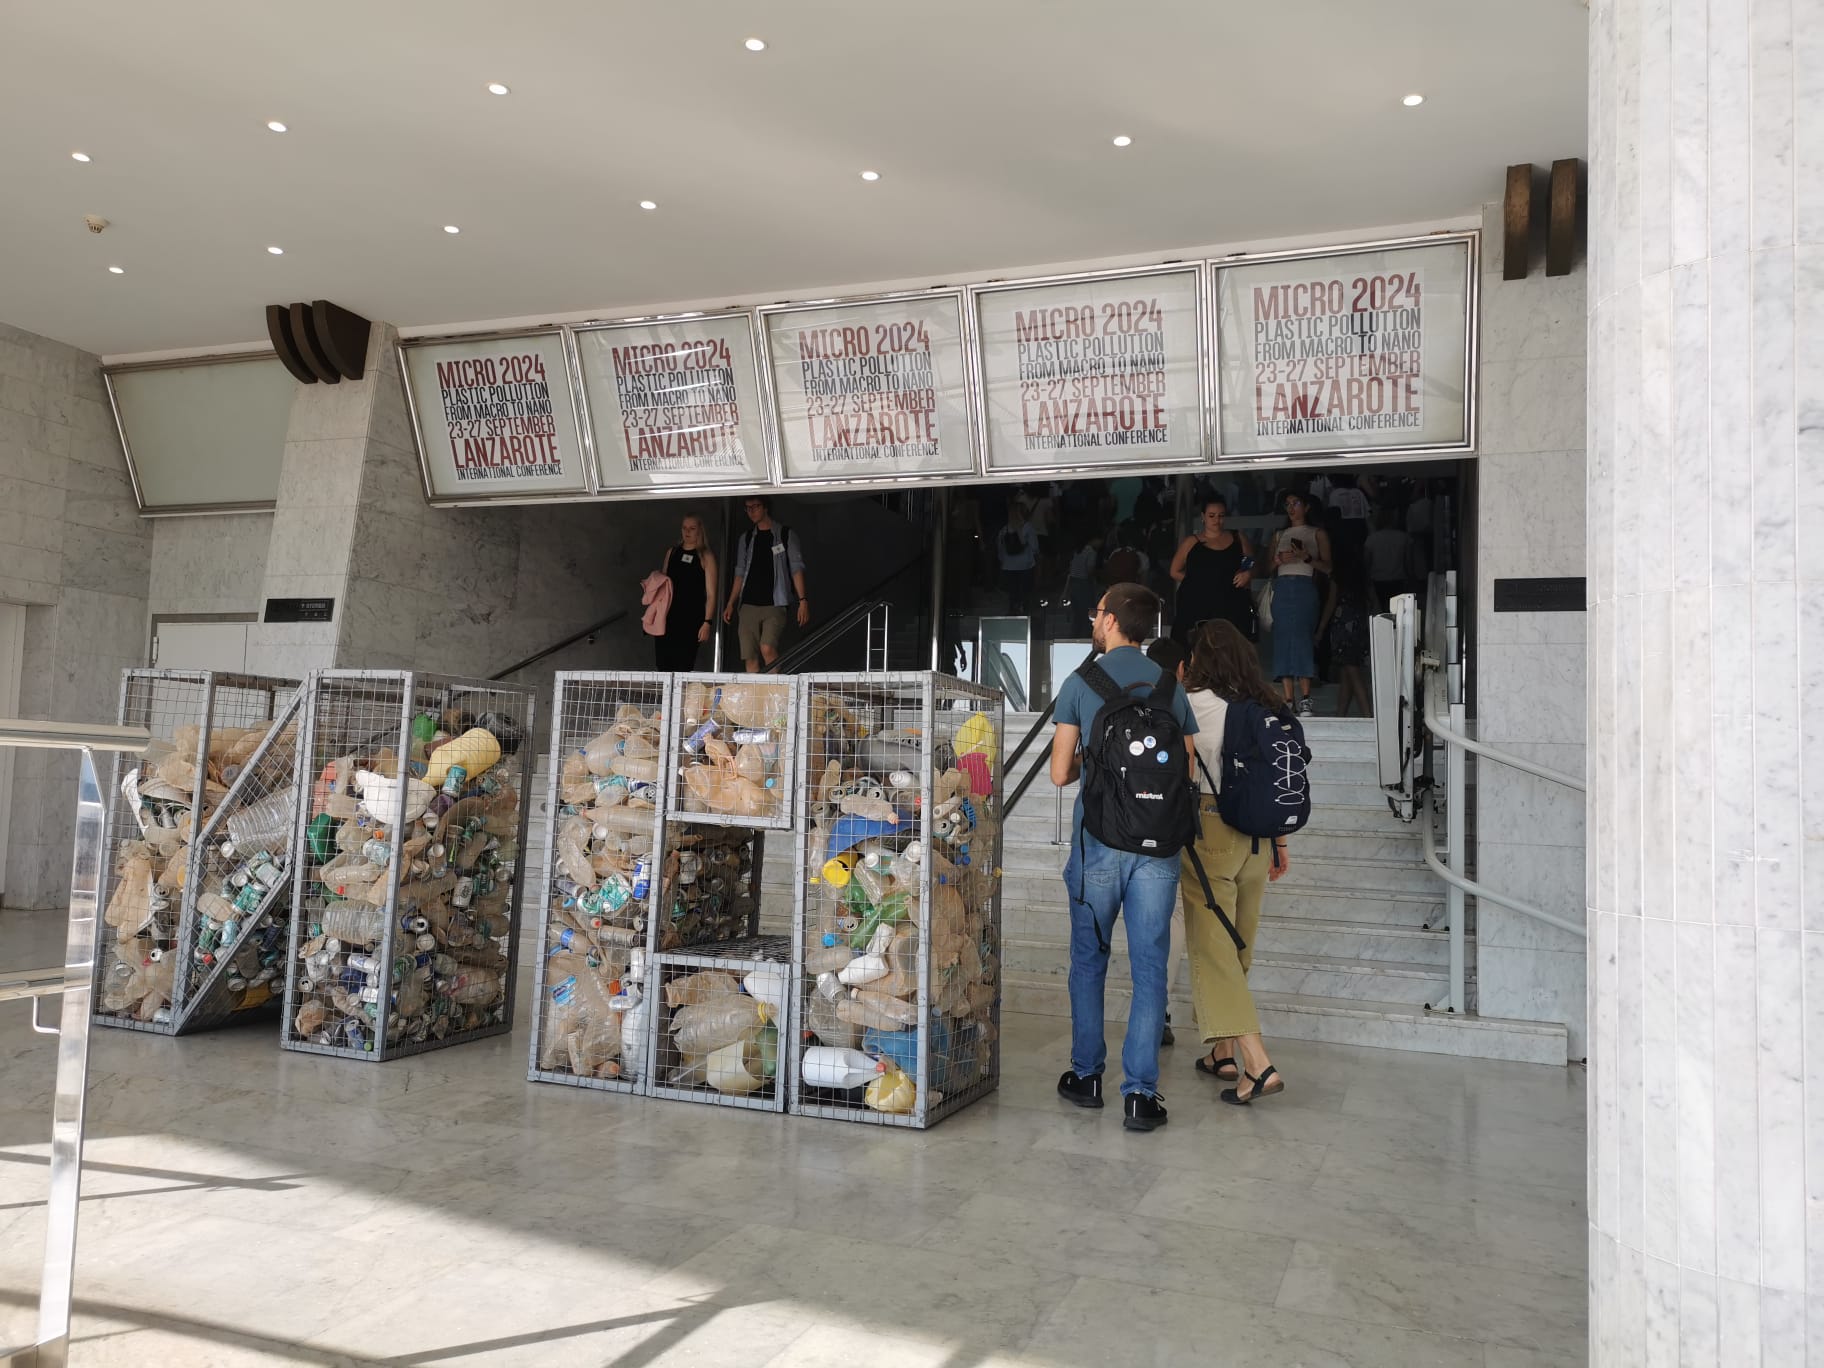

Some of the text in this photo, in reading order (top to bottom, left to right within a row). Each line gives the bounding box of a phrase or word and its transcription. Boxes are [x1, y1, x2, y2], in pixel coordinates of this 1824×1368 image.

[1254, 272, 1421, 321] MICRO 2024
[1016, 299, 1162, 342] MICRO 2024
[1255, 308, 1420, 342] PLASTIC POLLUTION
[799, 320, 929, 360] MICRO 2024
[1018, 331, 1164, 363] PLASTIC POLLUTION
[1255, 330, 1421, 362] FROM MACRO TO NANO
[437, 354, 545, 389] MICRO 2024
[612, 338, 731, 376] MICRO 2024
[802, 352, 932, 380] PLASTIC POLLUTION
[1020, 352, 1165, 380] FROM MACRO TO NANO
[1255, 350, 1420, 385] 23-27 SEPTEMBER
[442, 382, 549, 406] PLASTIC POLLUTION
[616, 368, 734, 394] PLASTIC POLLUTION
[804, 371, 933, 396] FROM MACRO TO NANO
[1021, 371, 1165, 401] 23-27 SEPTEMBER
[445, 400, 552, 421] FROM MACRO TO NANO
[620, 386, 736, 410] FROM MACRO TO NANO
[806, 388, 935, 416] 23-27 SEPTEMBER
[1256, 374, 1420, 422] LANZAROTE
[448, 415, 555, 439] 23-27 SEPTEMBER
[622, 402, 739, 428] 23-27 SEPTEMBER
[808, 409, 938, 448] LANZAROTE
[1022, 393, 1167, 437] LANZAROTE
[1257, 412, 1419, 436] INTERNATIONAL CONFERENCE
[451, 433, 560, 468] LANZAROTE
[813, 443, 939, 461] INTERNATIONAL CONFERENCE
[1025, 429, 1168, 450] INTERNATIONAL CONFERENCE
[456, 463, 562, 480] INTERNATIONAL CONFERENCE
